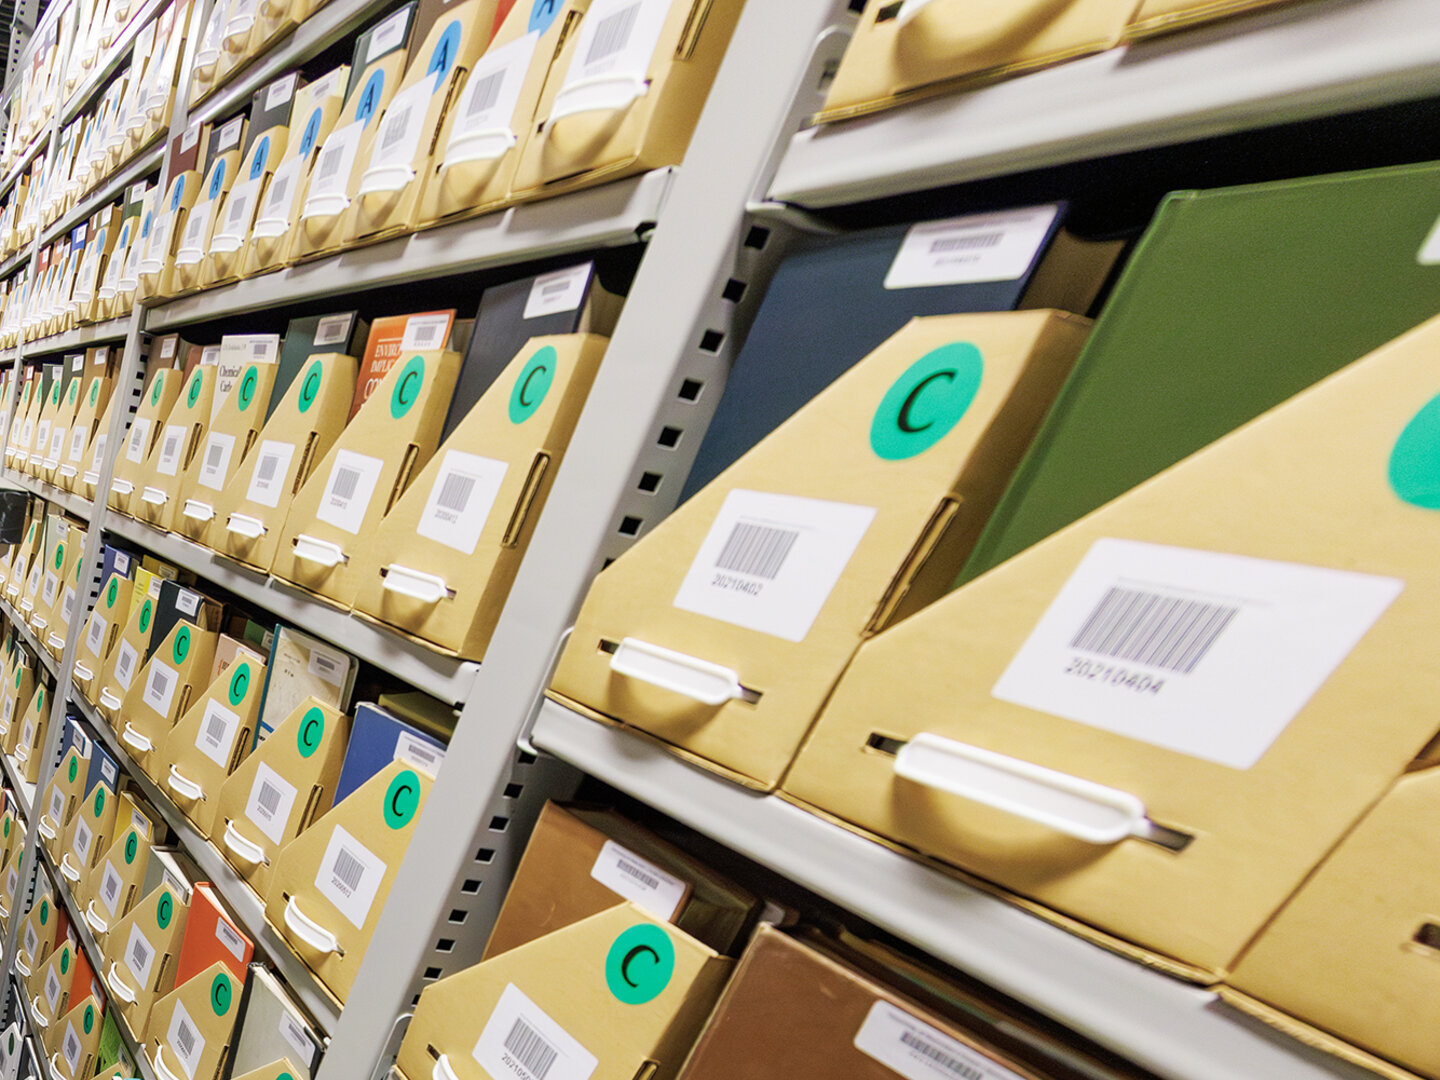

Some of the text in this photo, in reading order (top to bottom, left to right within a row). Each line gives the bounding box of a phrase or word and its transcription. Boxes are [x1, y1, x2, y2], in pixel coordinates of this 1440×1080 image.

[435, 39, 449, 72] A
[364, 84, 374, 113] A
[243, 377, 254, 401] C
[304, 373, 317, 401] C
[399, 371, 417, 405] C
[519, 366, 546, 407] C
[897, 371, 956, 433] C
[142, 608, 149, 626] C
[177, 636, 187, 656] C
[234, 674, 246, 697] C
[1061, 655, 1164, 697] 20210404
[304, 720, 318, 746] C
[392, 785, 412, 816] C
[127, 839, 134, 856] C
[160, 901, 168, 920] C
[621, 945, 659, 987] C
[215, 983, 227, 1006] C
